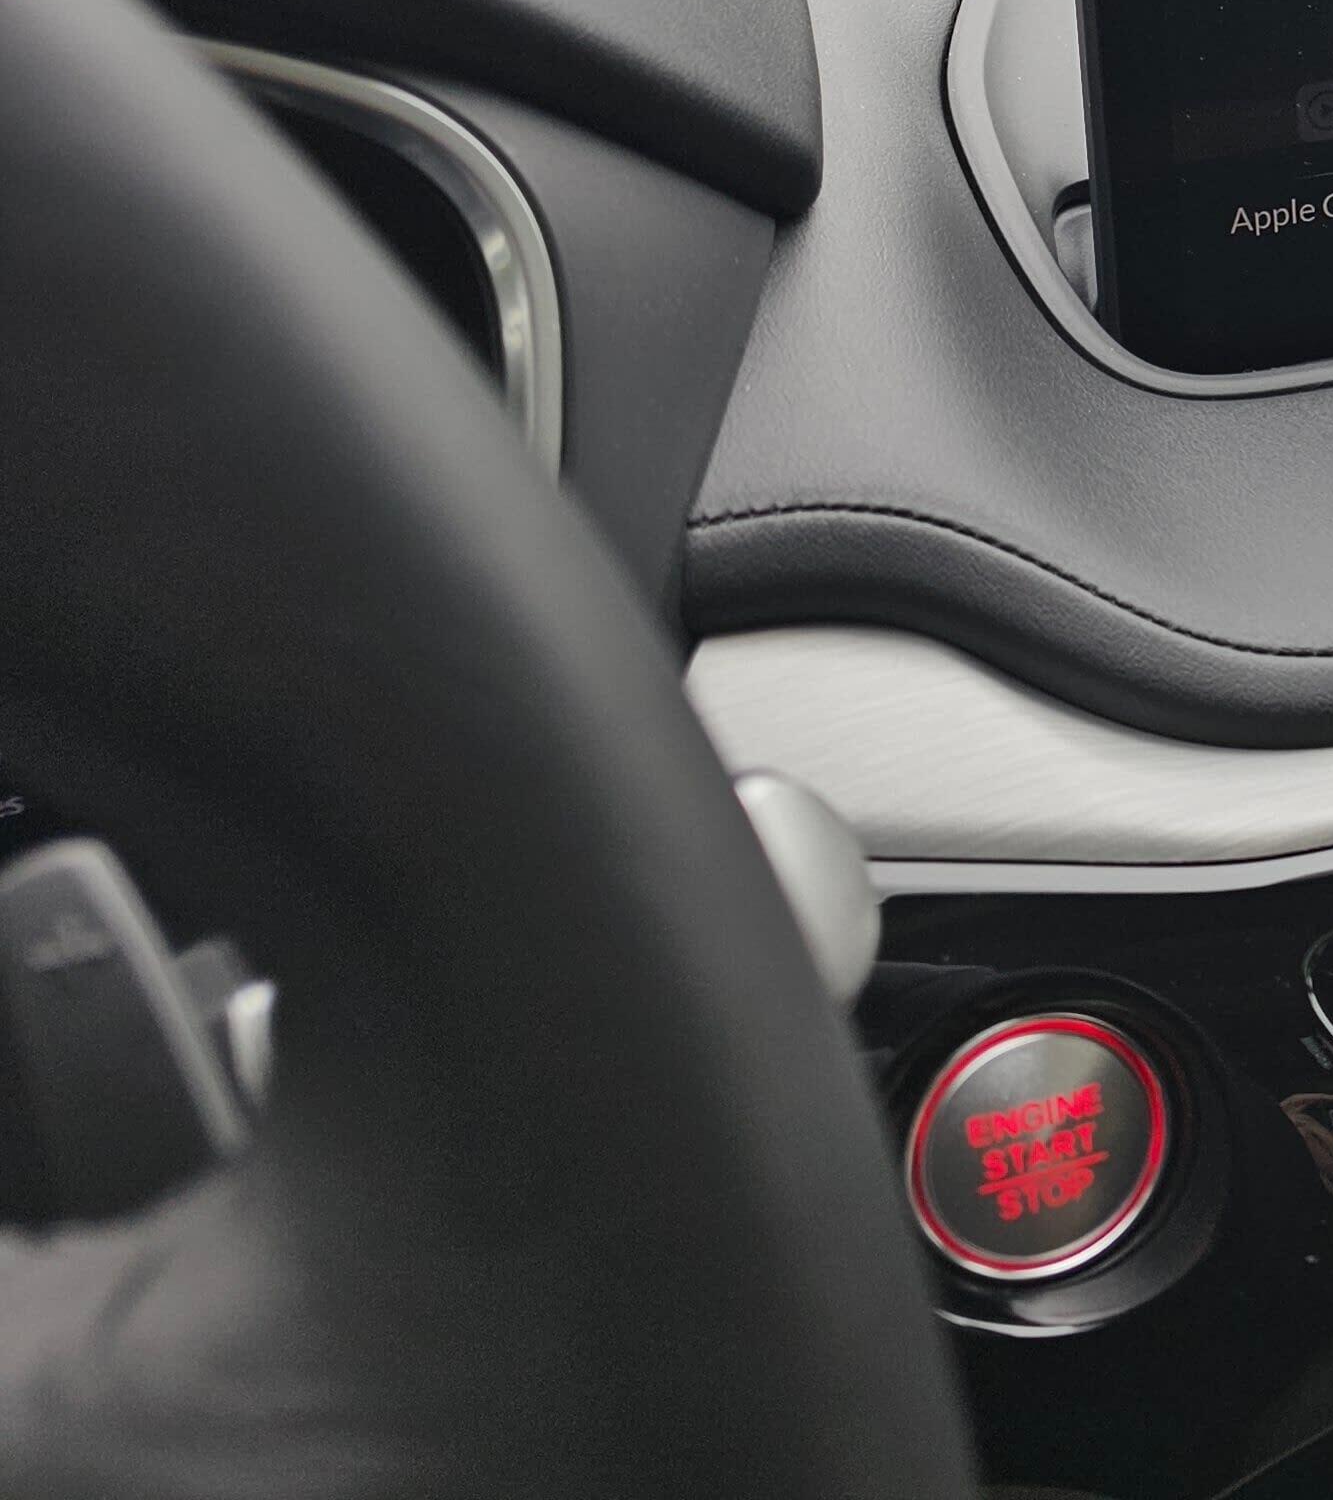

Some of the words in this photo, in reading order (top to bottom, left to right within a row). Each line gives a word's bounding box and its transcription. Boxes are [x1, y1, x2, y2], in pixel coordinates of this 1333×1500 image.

[1230, 198, 1316, 237] Apple
[966, 1083, 1102, 1147] ENGINE
[982, 1123, 1096, 1181] START
[997, 1167, 1094, 1221] STOP
